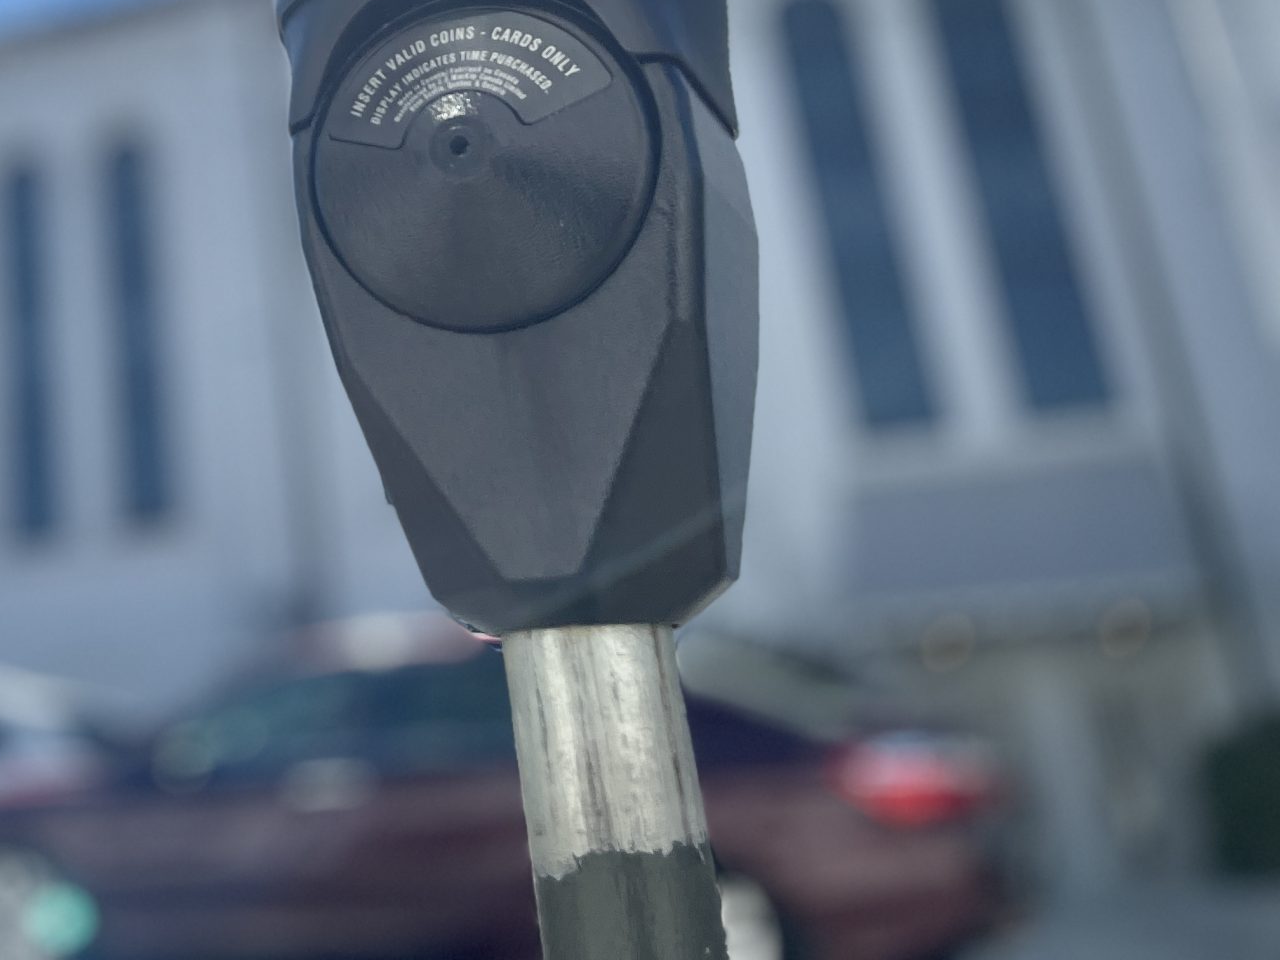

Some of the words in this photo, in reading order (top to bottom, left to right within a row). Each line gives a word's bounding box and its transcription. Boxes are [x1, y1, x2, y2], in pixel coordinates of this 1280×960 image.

[349, 68, 387, 117] INSERT
[385, 40, 426, 70] VALID
[430, 26, 476, 47] COINS
[491, 26, 542, 52] CARDS
[541, 45, 581, 77] ONLY
[370, 83, 403, 125] DISPLAY
[401, 52, 456, 85] INDICATES
[459, 50, 488, 61] TIME
